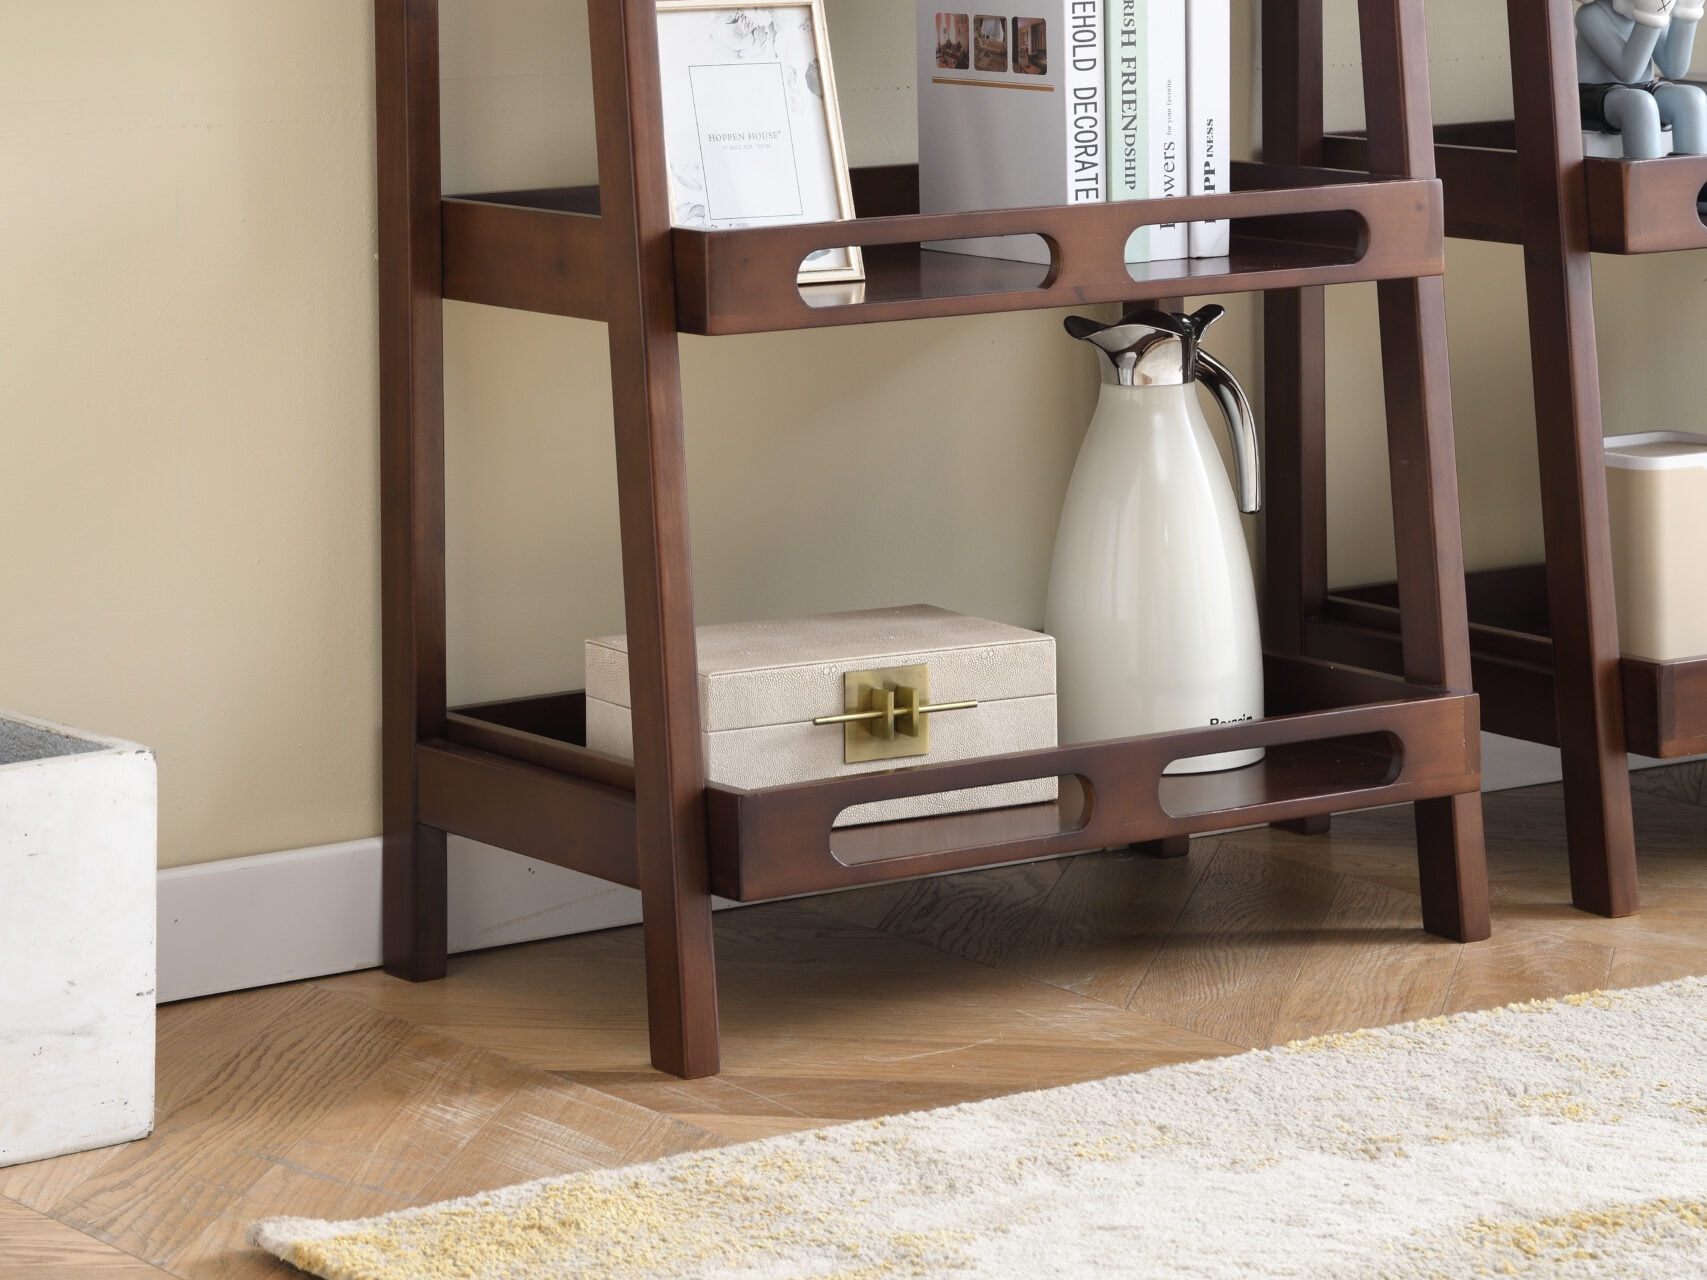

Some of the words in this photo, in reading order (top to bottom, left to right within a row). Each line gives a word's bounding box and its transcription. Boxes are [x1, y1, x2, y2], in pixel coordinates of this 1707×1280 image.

[708, 132, 745, 142] HOPPEN
[1073, 86, 1099, 201] DECORATE
[1121, 55, 1138, 190] FRIENDSHIP
[1203, 118, 1217, 224] PPINESS
